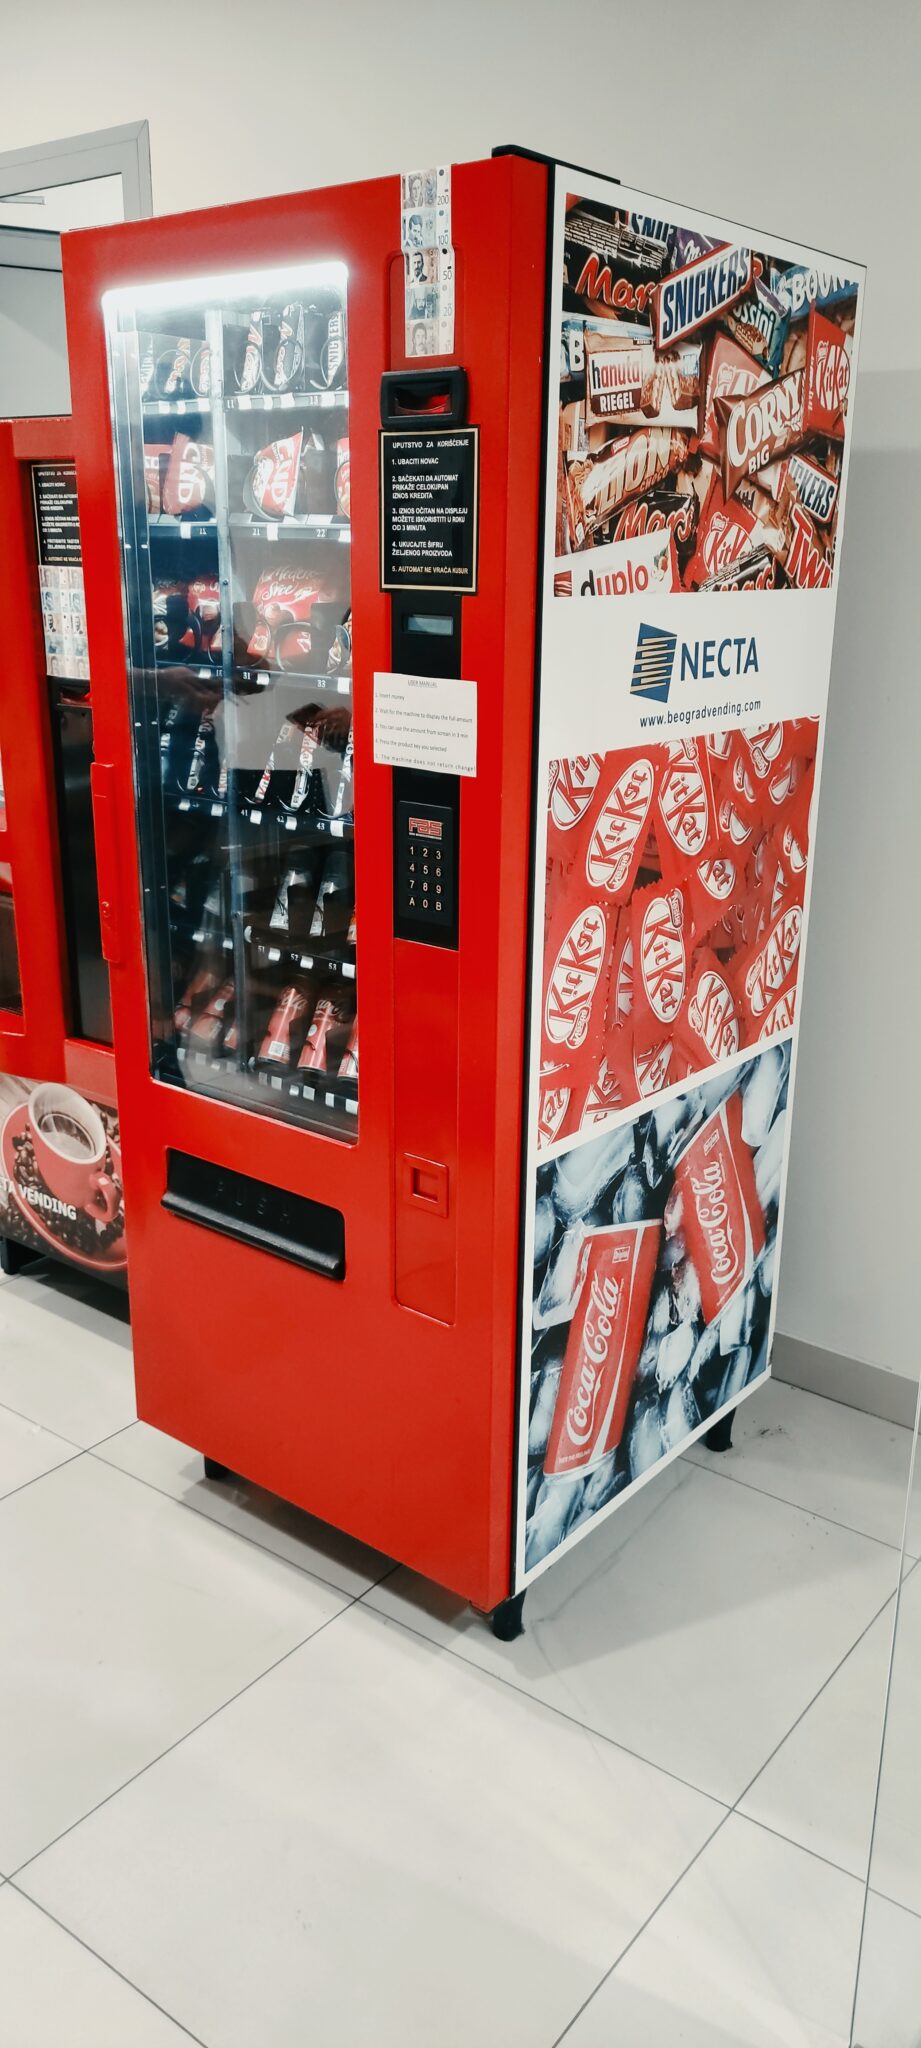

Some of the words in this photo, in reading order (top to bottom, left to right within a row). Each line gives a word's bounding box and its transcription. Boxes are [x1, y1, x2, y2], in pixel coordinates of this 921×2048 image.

[438, 194, 449, 206] 200
[438, 234, 449, 246] 100
[442, 269, 452, 280] 50
[575, 252, 656, 313] Mar
[792, 268, 851, 313] BOUN
[661, 247, 750, 340] SNICKERS
[600, 391, 635, 413] RIEGEL
[727, 370, 803, 468] CORNY
[748, 444, 770, 475] BIG
[581, 560, 648, 597] duplo
[680, 637, 759, 681] NECTA
[639, 699, 761, 728] www.beogradvending.com
[660, 751, 706, 847] KitKat
[410, 846, 414, 855] 1
[423, 848, 428, 857] 2
[436, 850, 441, 860] 3
[410, 864, 414, 872] 4
[423, 865, 428, 874] 5
[436, 868, 441, 877] 6
[410, 880, 414, 889] 7
[423, 882, 428, 891] 8
[436, 885, 441, 894] 9
[409, 897, 415, 906] A
[423, 899, 428, 908] 0
[436, 902, 441, 911] B
[643, 913, 684, 1014] KitKat
[18, 1183, 77, 1221] VENDING
[567, 1270, 618, 1446] Coca-Cola
